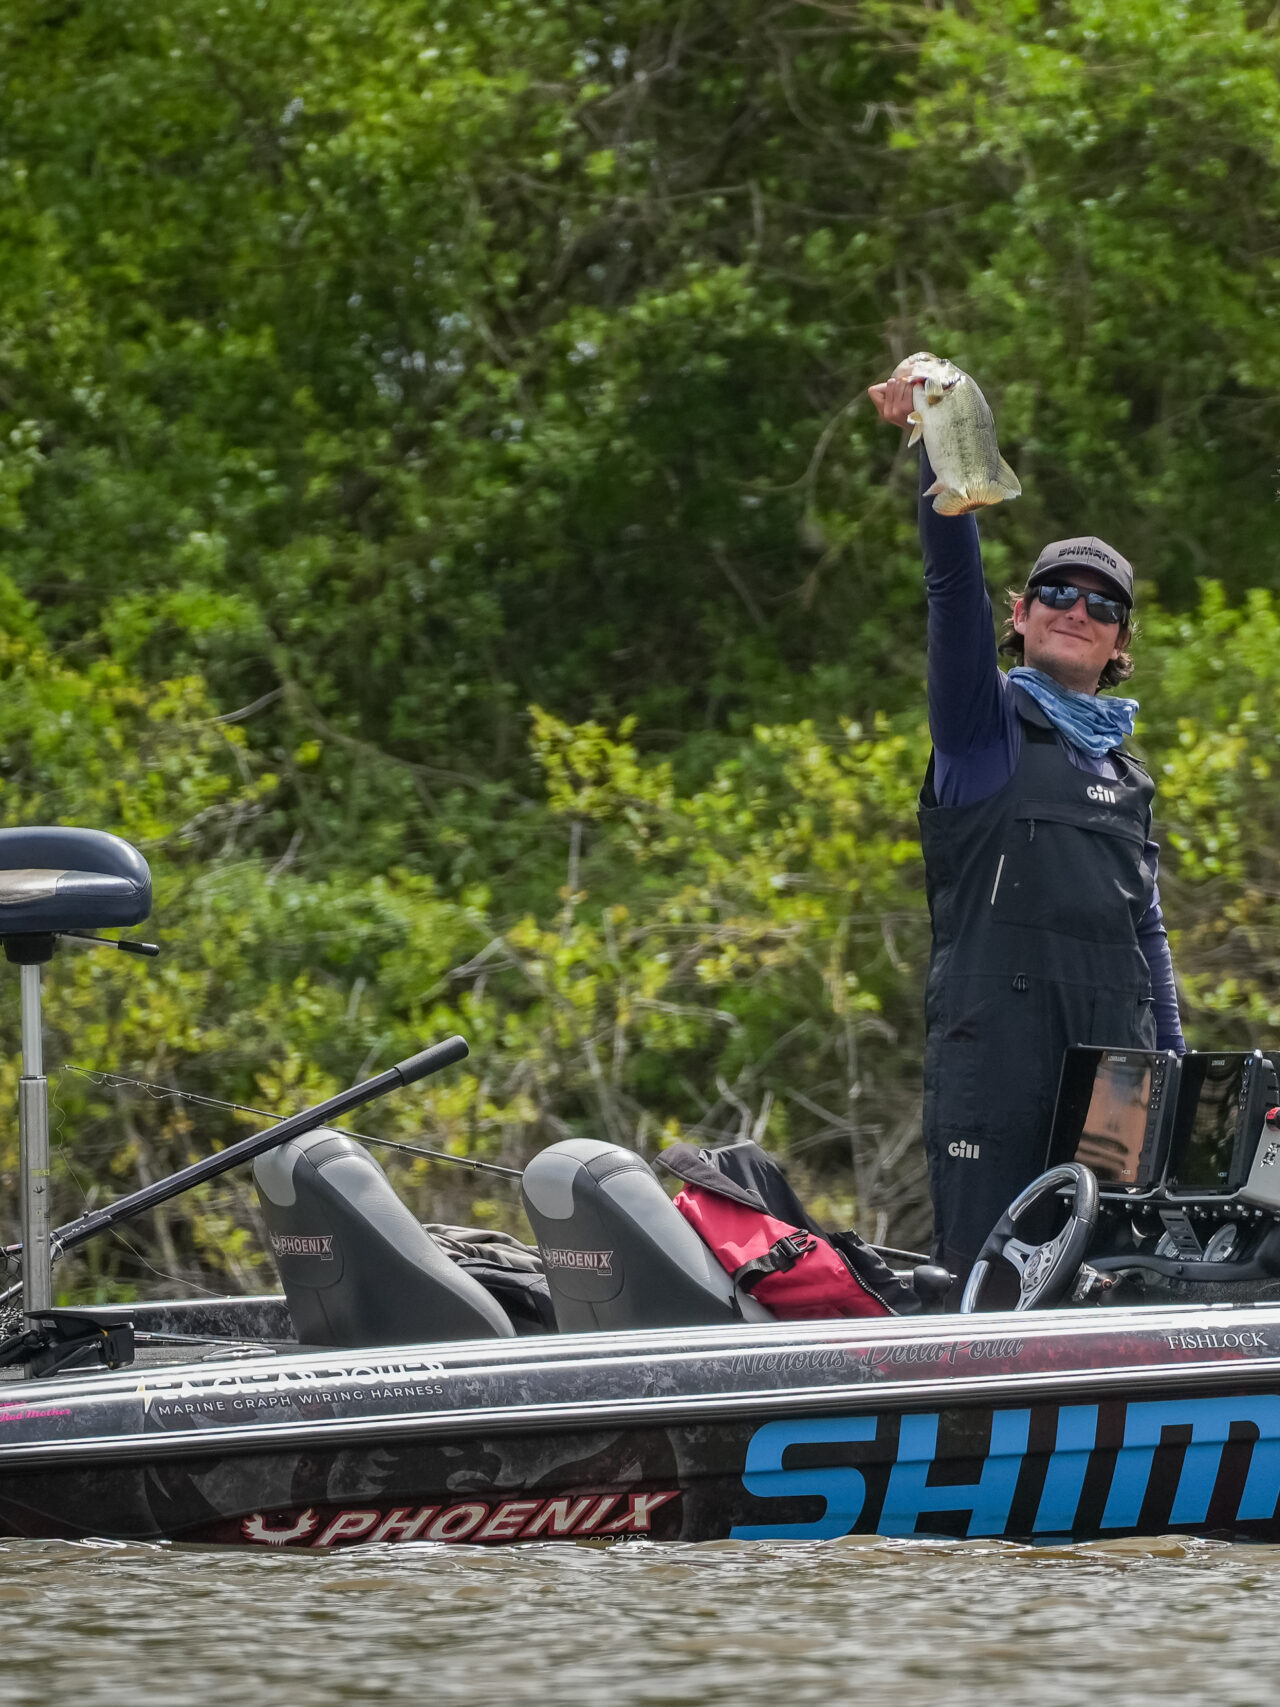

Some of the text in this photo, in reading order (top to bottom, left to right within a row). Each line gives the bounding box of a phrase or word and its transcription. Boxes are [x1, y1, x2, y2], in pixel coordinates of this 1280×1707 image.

[1086, 784, 1116, 804] Gill
[948, 1140, 980, 1159] Gill
[281, 1238, 330, 1253] PHOENIX
[552, 1251, 610, 1269] PHOENIX
[1168, 1332, 1269, 1350] FISHLOCK
[158, 1384, 444, 1416] MARINE GRAPH WIRING HARNESS
[316, 1491, 678, 1546] PHOENIX
